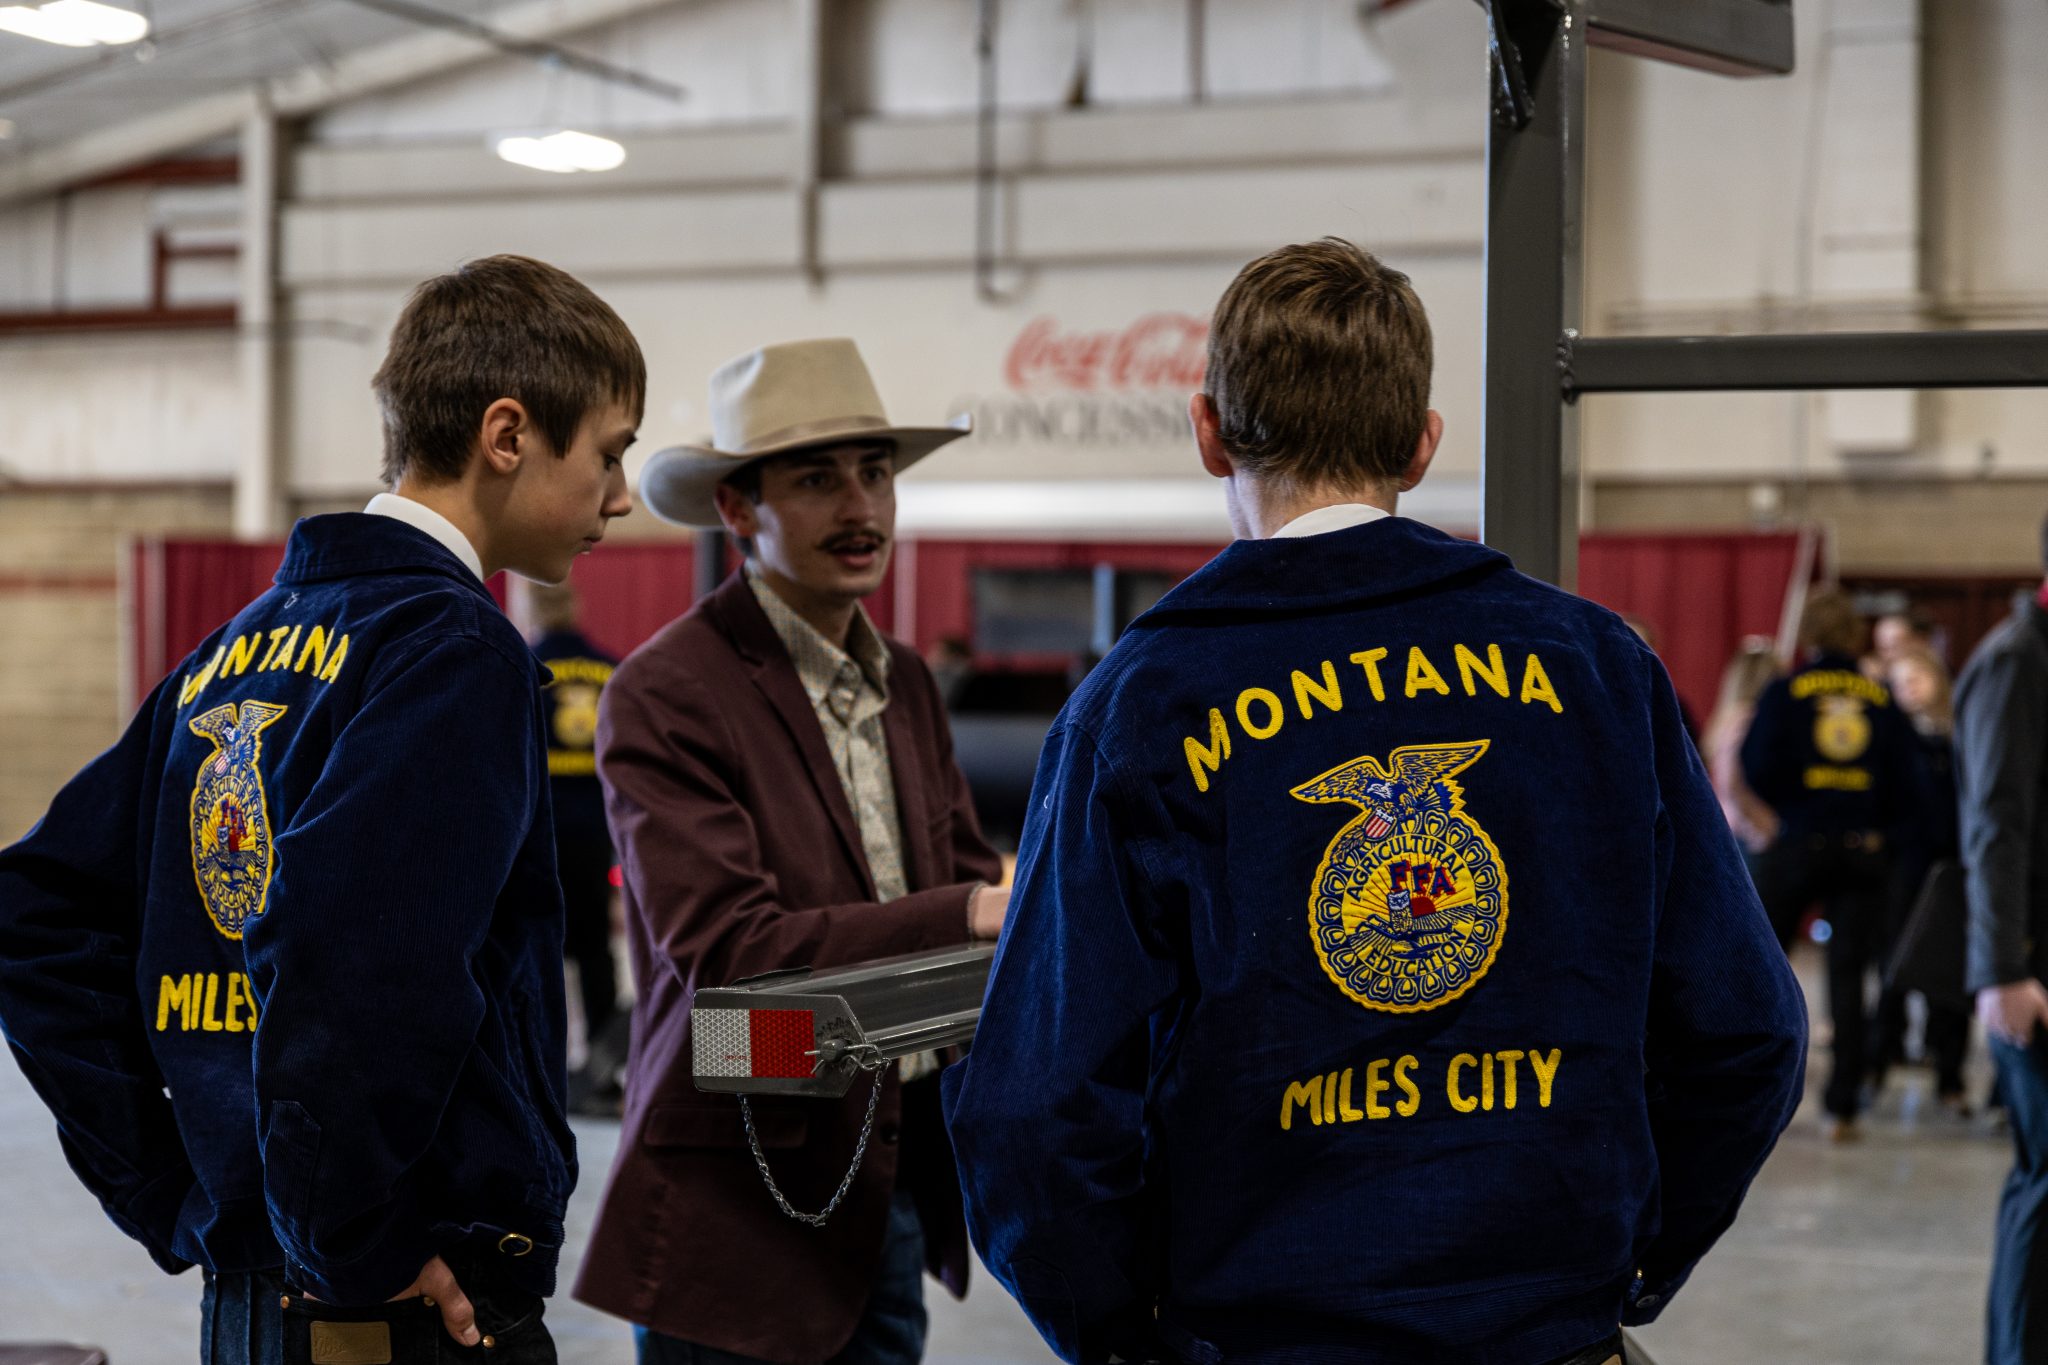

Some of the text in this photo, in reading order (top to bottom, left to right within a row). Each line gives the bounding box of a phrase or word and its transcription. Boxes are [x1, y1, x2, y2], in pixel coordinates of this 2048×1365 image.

[1183, 643, 1564, 793] MONTANA
[1346, 835, 1466, 901] AGRICULTURAL
[1388, 860, 1457, 898] FFA
[1366, 928, 1467, 977] EDUCATION
[1280, 1048, 1562, 1131] MILES CITY
